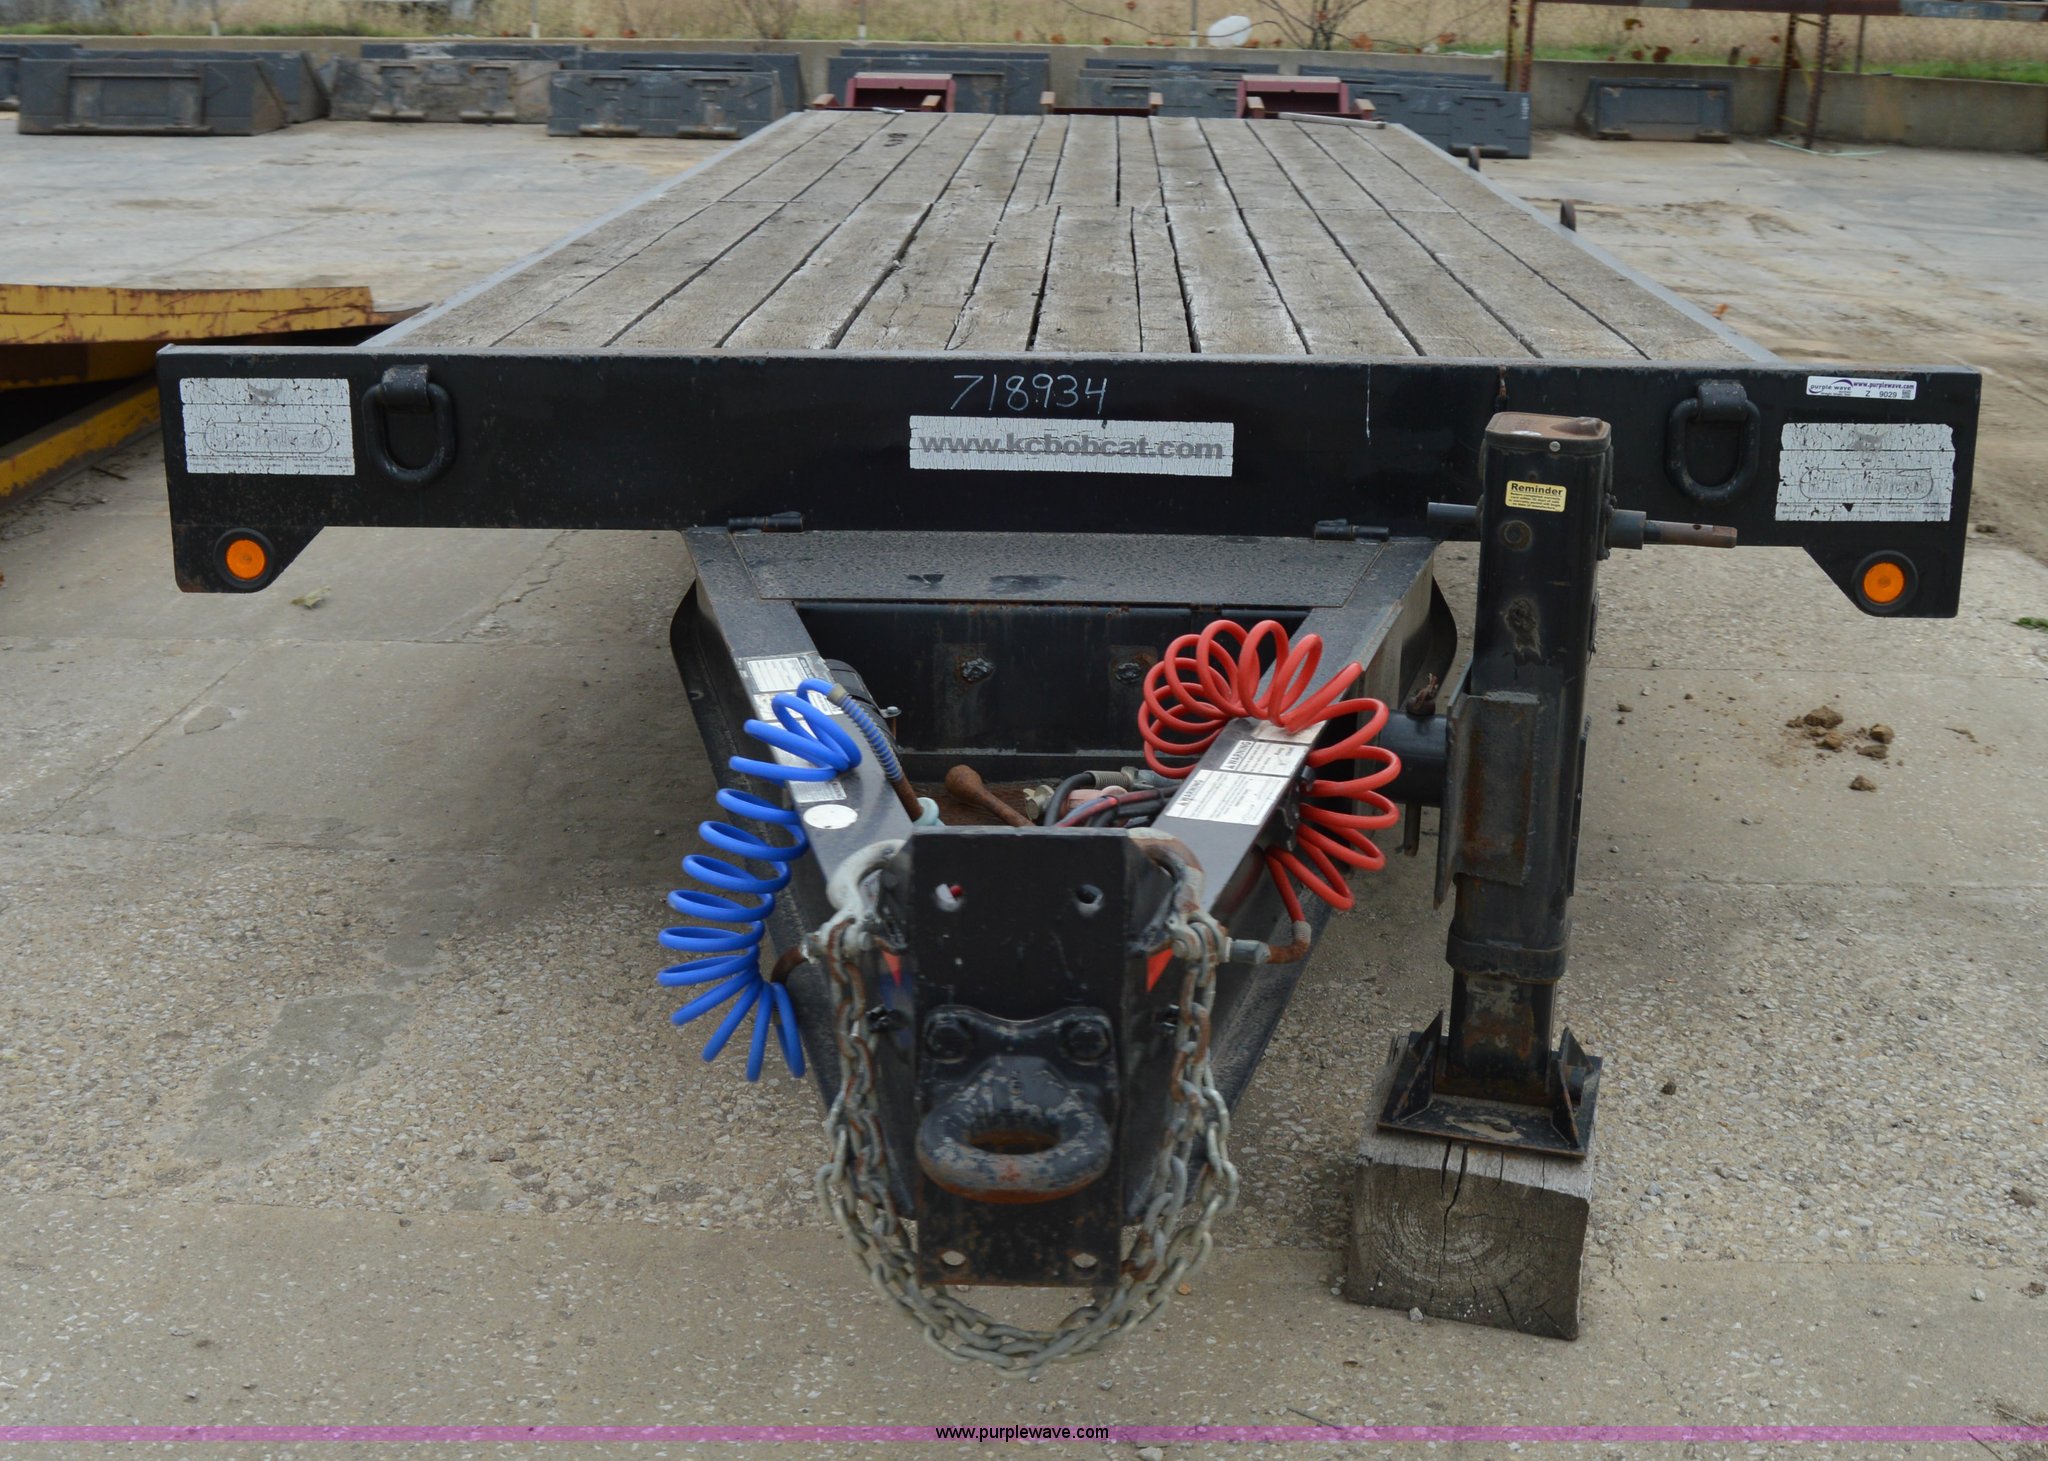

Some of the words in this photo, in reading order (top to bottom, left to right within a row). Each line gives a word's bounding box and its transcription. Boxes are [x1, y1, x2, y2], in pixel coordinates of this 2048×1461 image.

[1810, 384, 1832, 392] purple
[1853, 381, 1914, 389] www.purplewave.com
[951, 373, 1108, 414] 718934
[1879, 390, 1898, 399] 9029
[919, 433, 1223, 459] www.kcbobcat.com
[1511, 483, 1563, 495] Reminder
